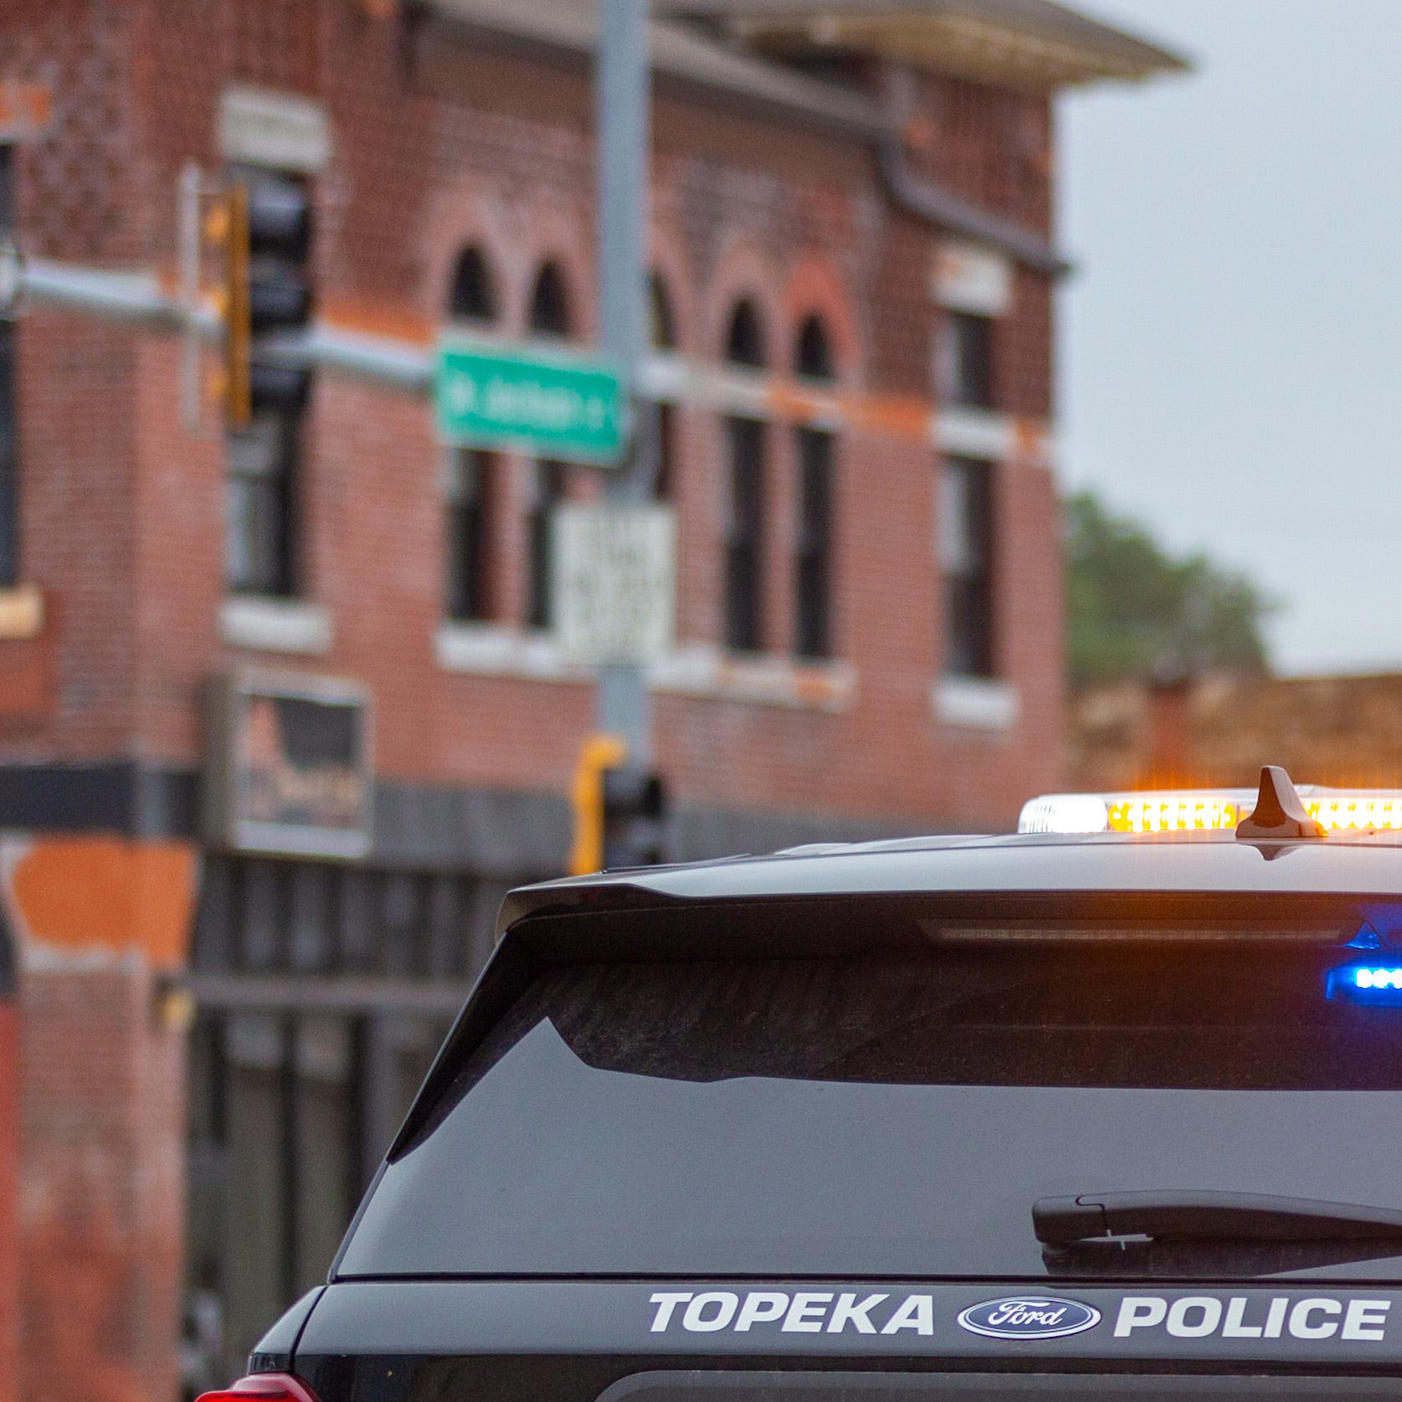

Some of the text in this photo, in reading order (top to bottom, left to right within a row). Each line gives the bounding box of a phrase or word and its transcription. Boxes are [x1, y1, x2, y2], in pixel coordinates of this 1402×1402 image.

[648, 1292, 1392, 1341] TOPEKA Ford POLICE
